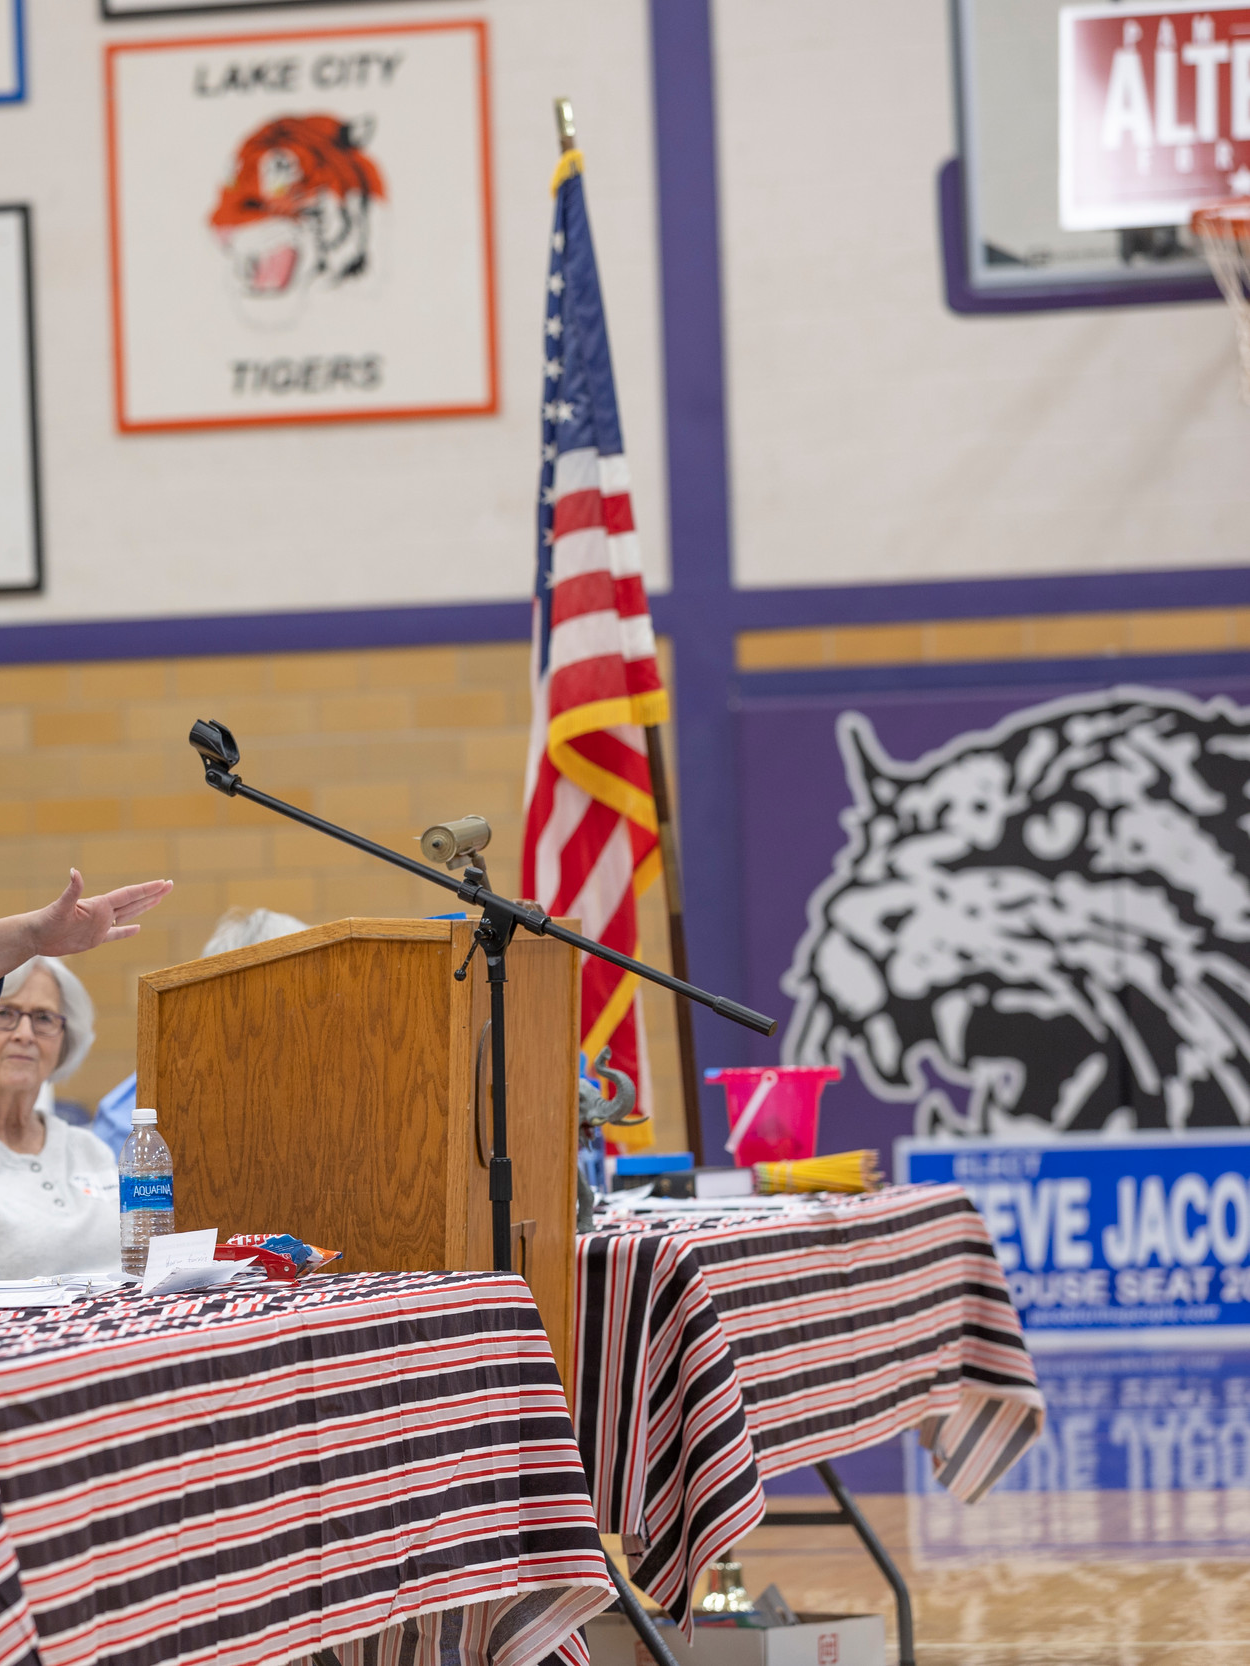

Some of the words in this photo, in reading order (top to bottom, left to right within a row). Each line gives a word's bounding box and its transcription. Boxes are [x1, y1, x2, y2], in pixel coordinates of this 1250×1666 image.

[195, 56, 304, 99] LAKE
[312, 51, 404, 93] CITY
[231, 354, 383, 397] TIGERS
[133, 1183, 173, 1198] AQUAFINA
[1101, 1171, 1250, 1271] JACO
[1007, 1267, 1111, 1311] OUSE
[1114, 1265, 1216, 1307] SEAT
